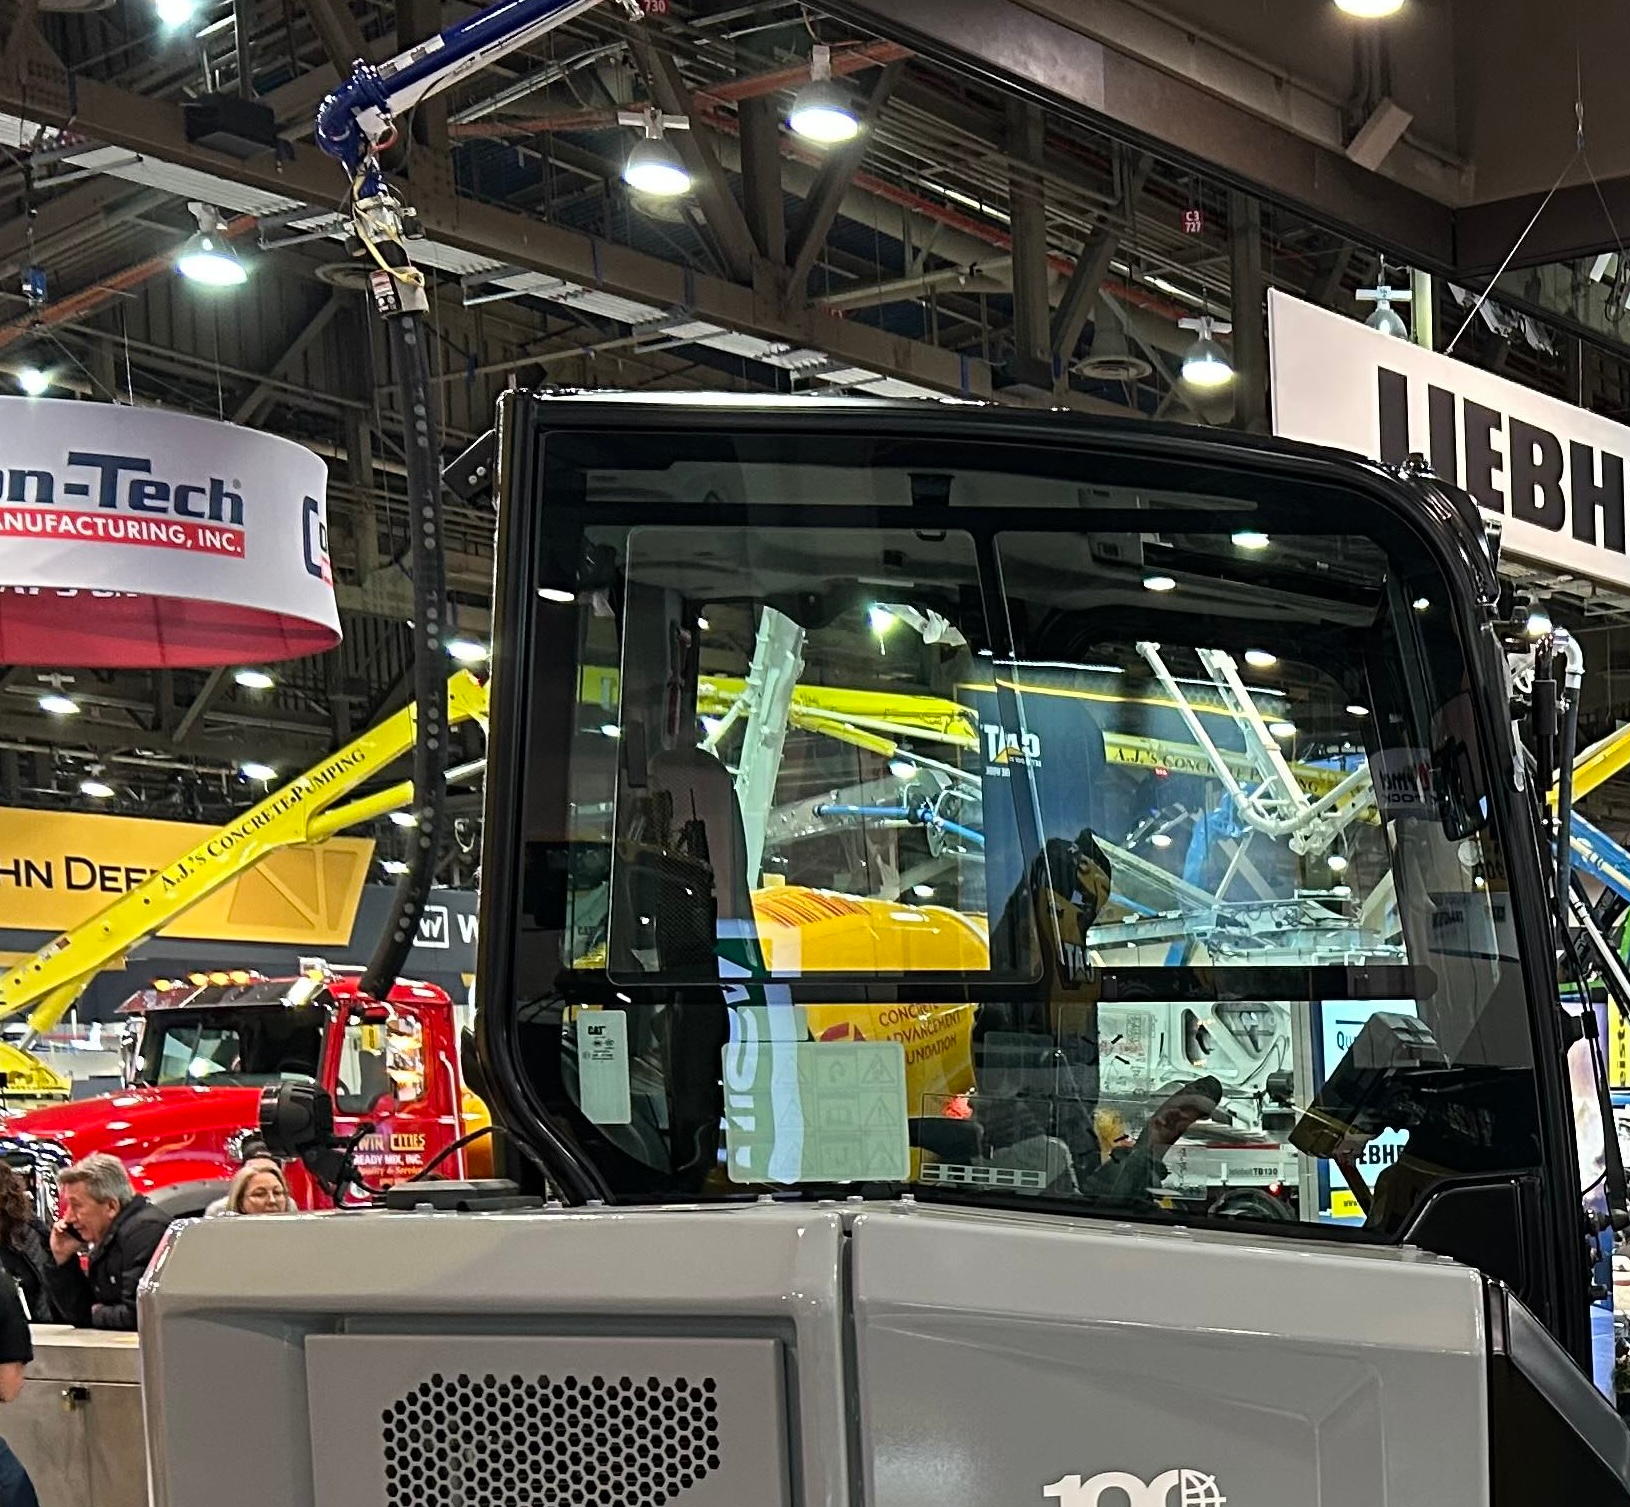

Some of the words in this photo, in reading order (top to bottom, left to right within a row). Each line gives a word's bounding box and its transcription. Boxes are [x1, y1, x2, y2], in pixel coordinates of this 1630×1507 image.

[0, 451, 244, 526] n-Tech
[198, 529, 242, 553] INC.
[293, 746, 367, 805] PUMPING
[65, 856, 159, 894] DEE
